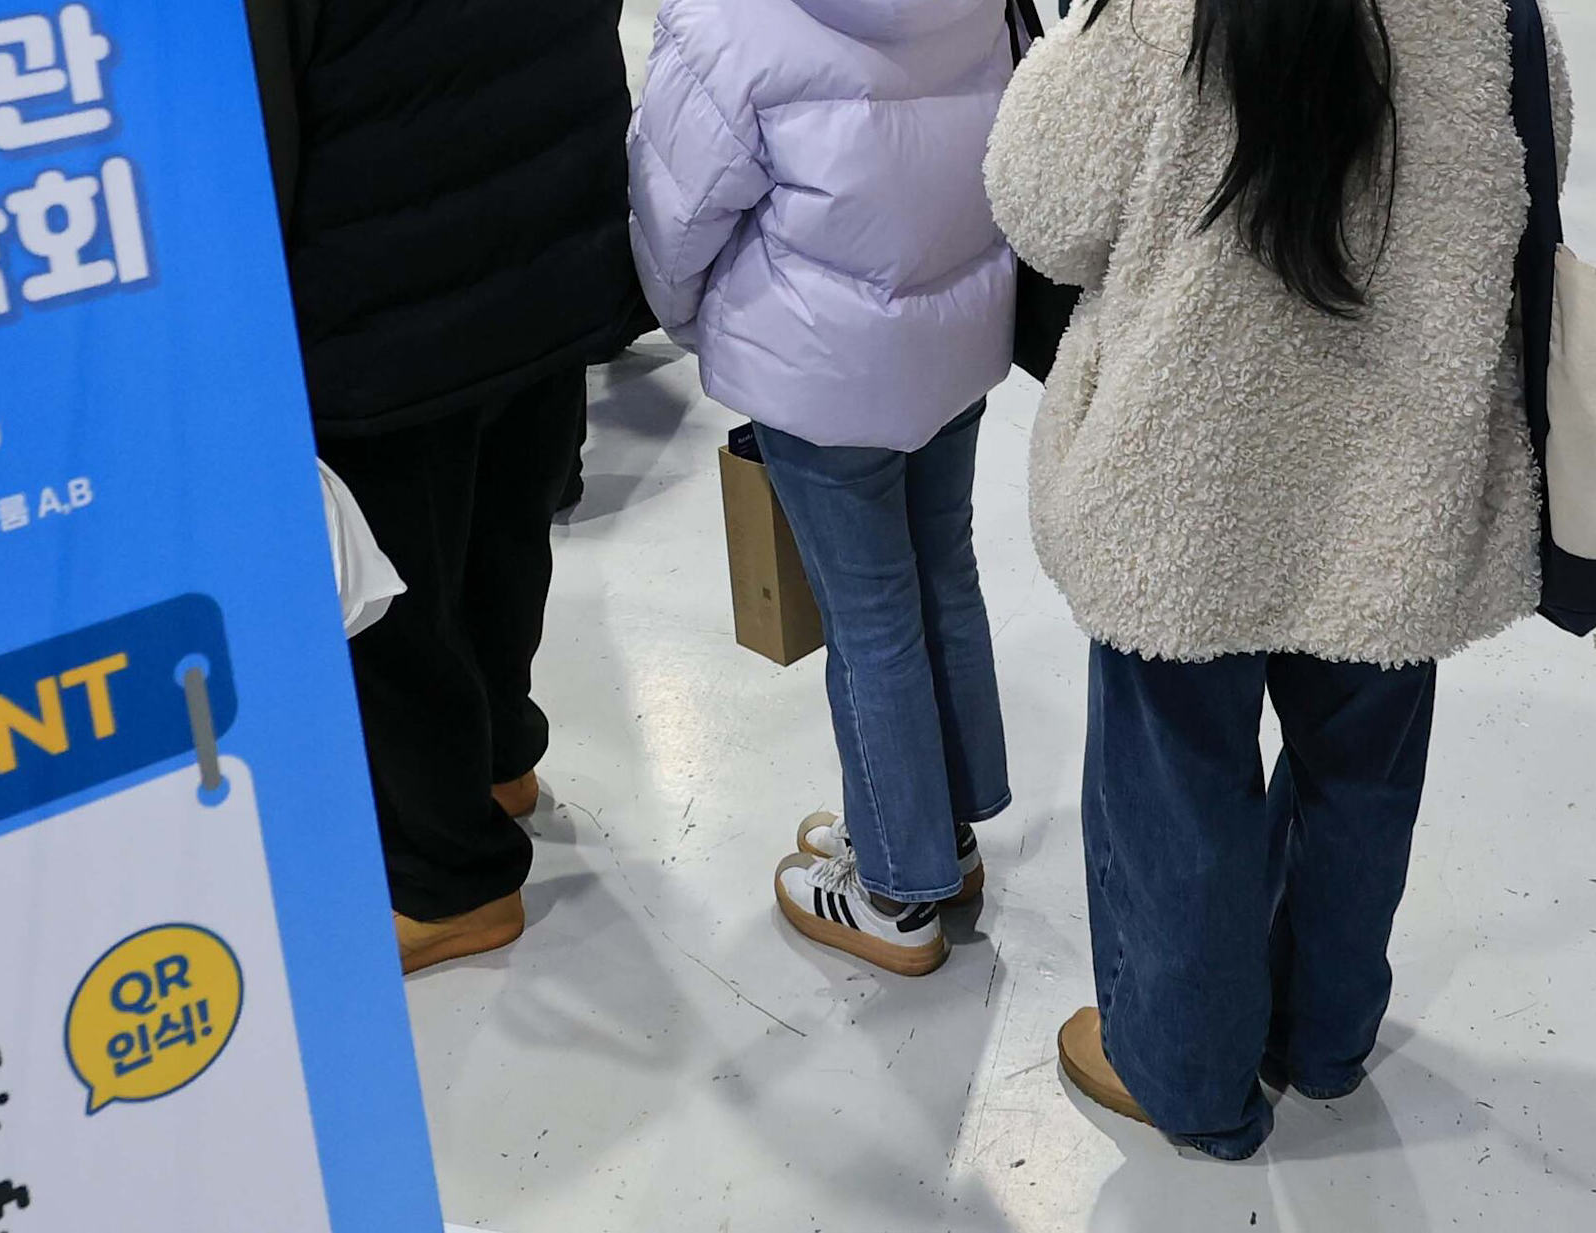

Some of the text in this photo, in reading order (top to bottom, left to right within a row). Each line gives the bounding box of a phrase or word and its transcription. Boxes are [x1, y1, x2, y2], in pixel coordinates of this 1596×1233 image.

[37, 476, 94, 518] A,B
[107, 950, 191, 1021] QR
[106, 1001, 214, 1077] 인식!
